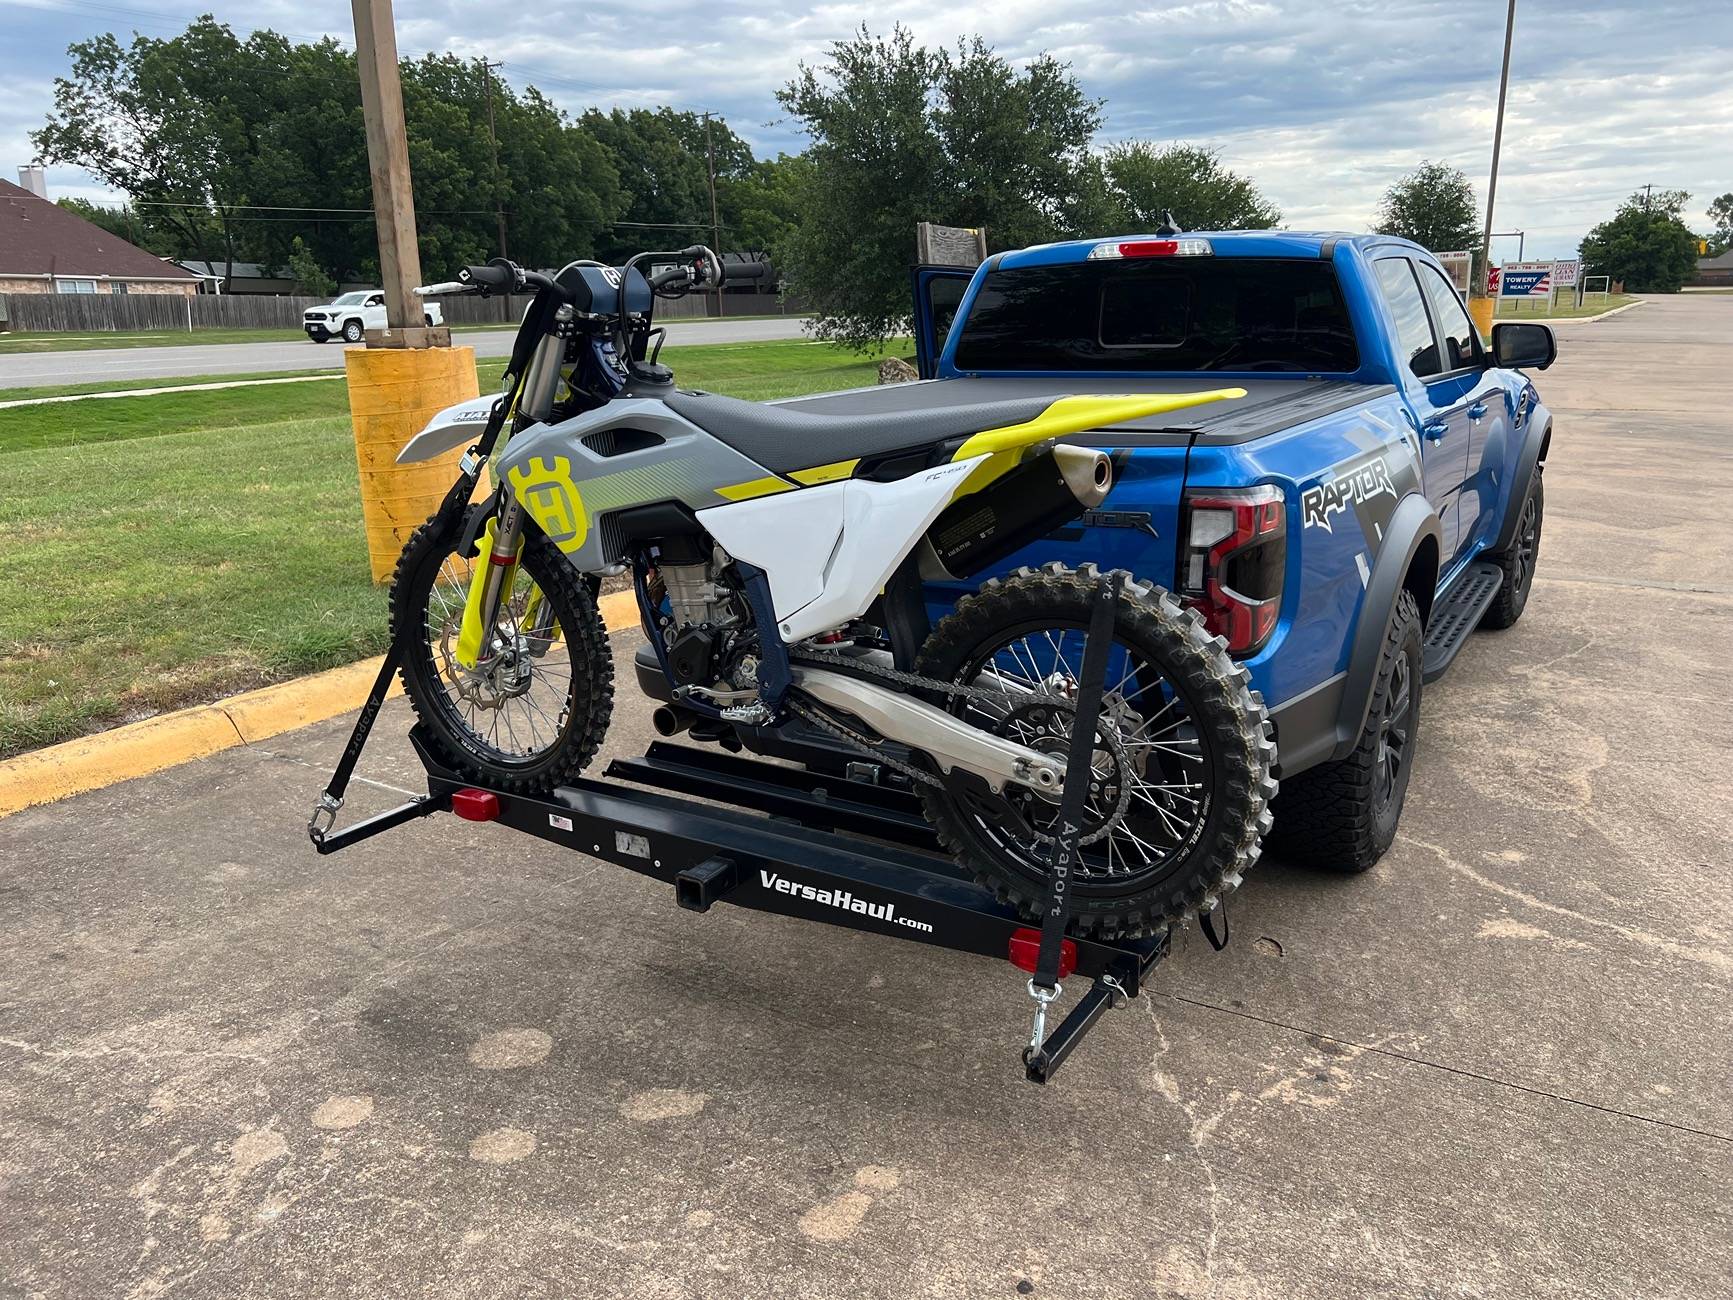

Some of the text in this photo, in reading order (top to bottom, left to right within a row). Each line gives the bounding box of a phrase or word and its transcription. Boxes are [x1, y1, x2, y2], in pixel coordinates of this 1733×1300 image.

[1302, 456, 1397, 534] RAPTOR
[760, 870, 933, 932] VersaHaul.com
[1052, 820, 1078, 916] Ayaport
